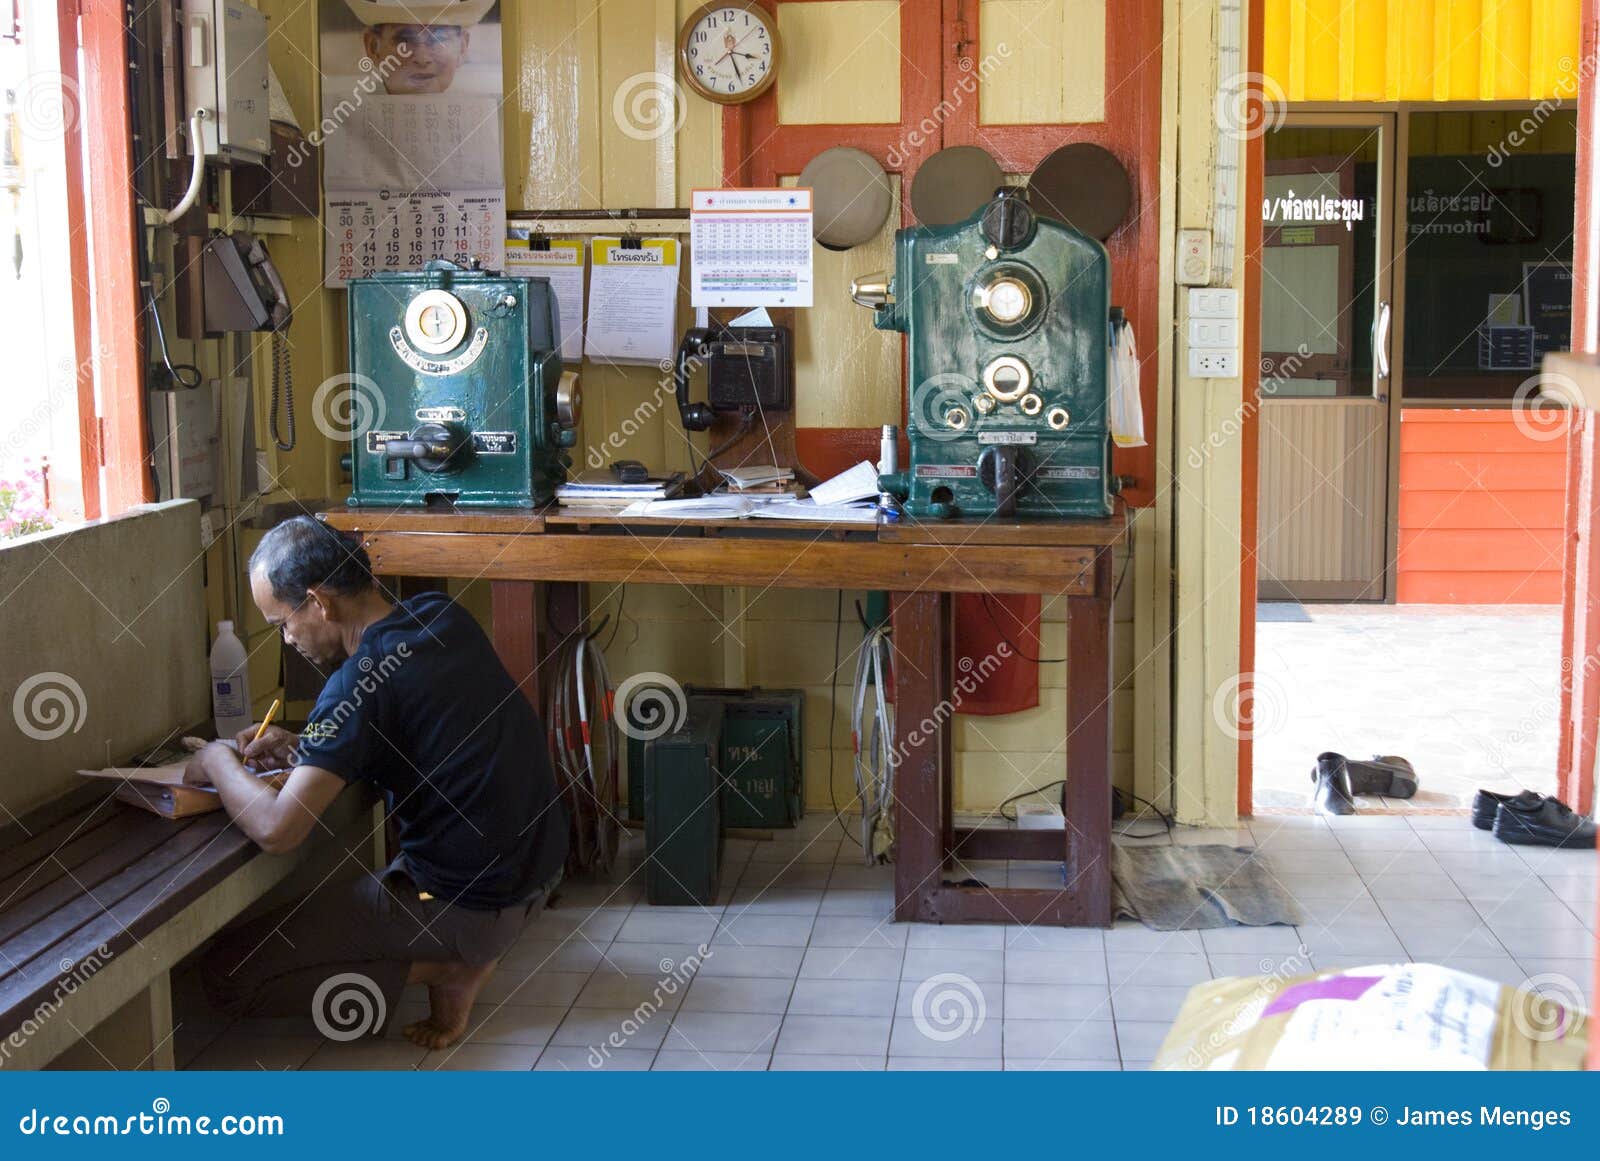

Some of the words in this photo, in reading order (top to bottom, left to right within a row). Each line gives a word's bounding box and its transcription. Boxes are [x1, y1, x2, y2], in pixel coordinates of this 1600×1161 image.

[724, 10, 735, 22] 12
[744, 15, 749, 26] 1
[707, 17, 717, 28] 11
[695, 31, 707, 43] 10
[758, 27, 765, 39] 2
[691, 47, 698, 58] 9
[763, 43, 770, 55] 3
[696, 64, 704, 76] 8
[759, 60, 766, 71] 4
[710, 77, 717, 88] 7
[748, 74, 755, 86] 5
[728, 81, 735, 92] 6
[339, 215, 353, 227] 30
[362, 215, 375, 226] 31
[393, 214, 398, 225] 1
[415, 213, 423, 224] 2
[438, 213, 445, 224] 3
[461, 212, 468, 223] 4
[484, 212, 491, 223] 5
[345, 228, 353, 240] 6
[369, 228, 376, 239] 7
[392, 228, 400, 238] 8
[415, 227, 423, 238] 9
[432, 226, 445, 237] 10
[455, 226, 467, 237] 11
[478, 225, 491, 236] 12
[339, 242, 353, 254] 13
[363, 242, 376, 253] 14
[386, 241, 399, 252] 15
[409, 241, 422, 251] 16
[432, 240, 444, 251] 17
[455, 240, 468, 250] 18
[478, 239, 491, 250] 19
[339, 256, 353, 267] 20
[363, 255, 376, 266] 21
[385, 255, 399, 266] 22
[409, 254, 423, 265] 23
[454, 252, 468, 264] 25
[339, 269, 353, 280] 27
